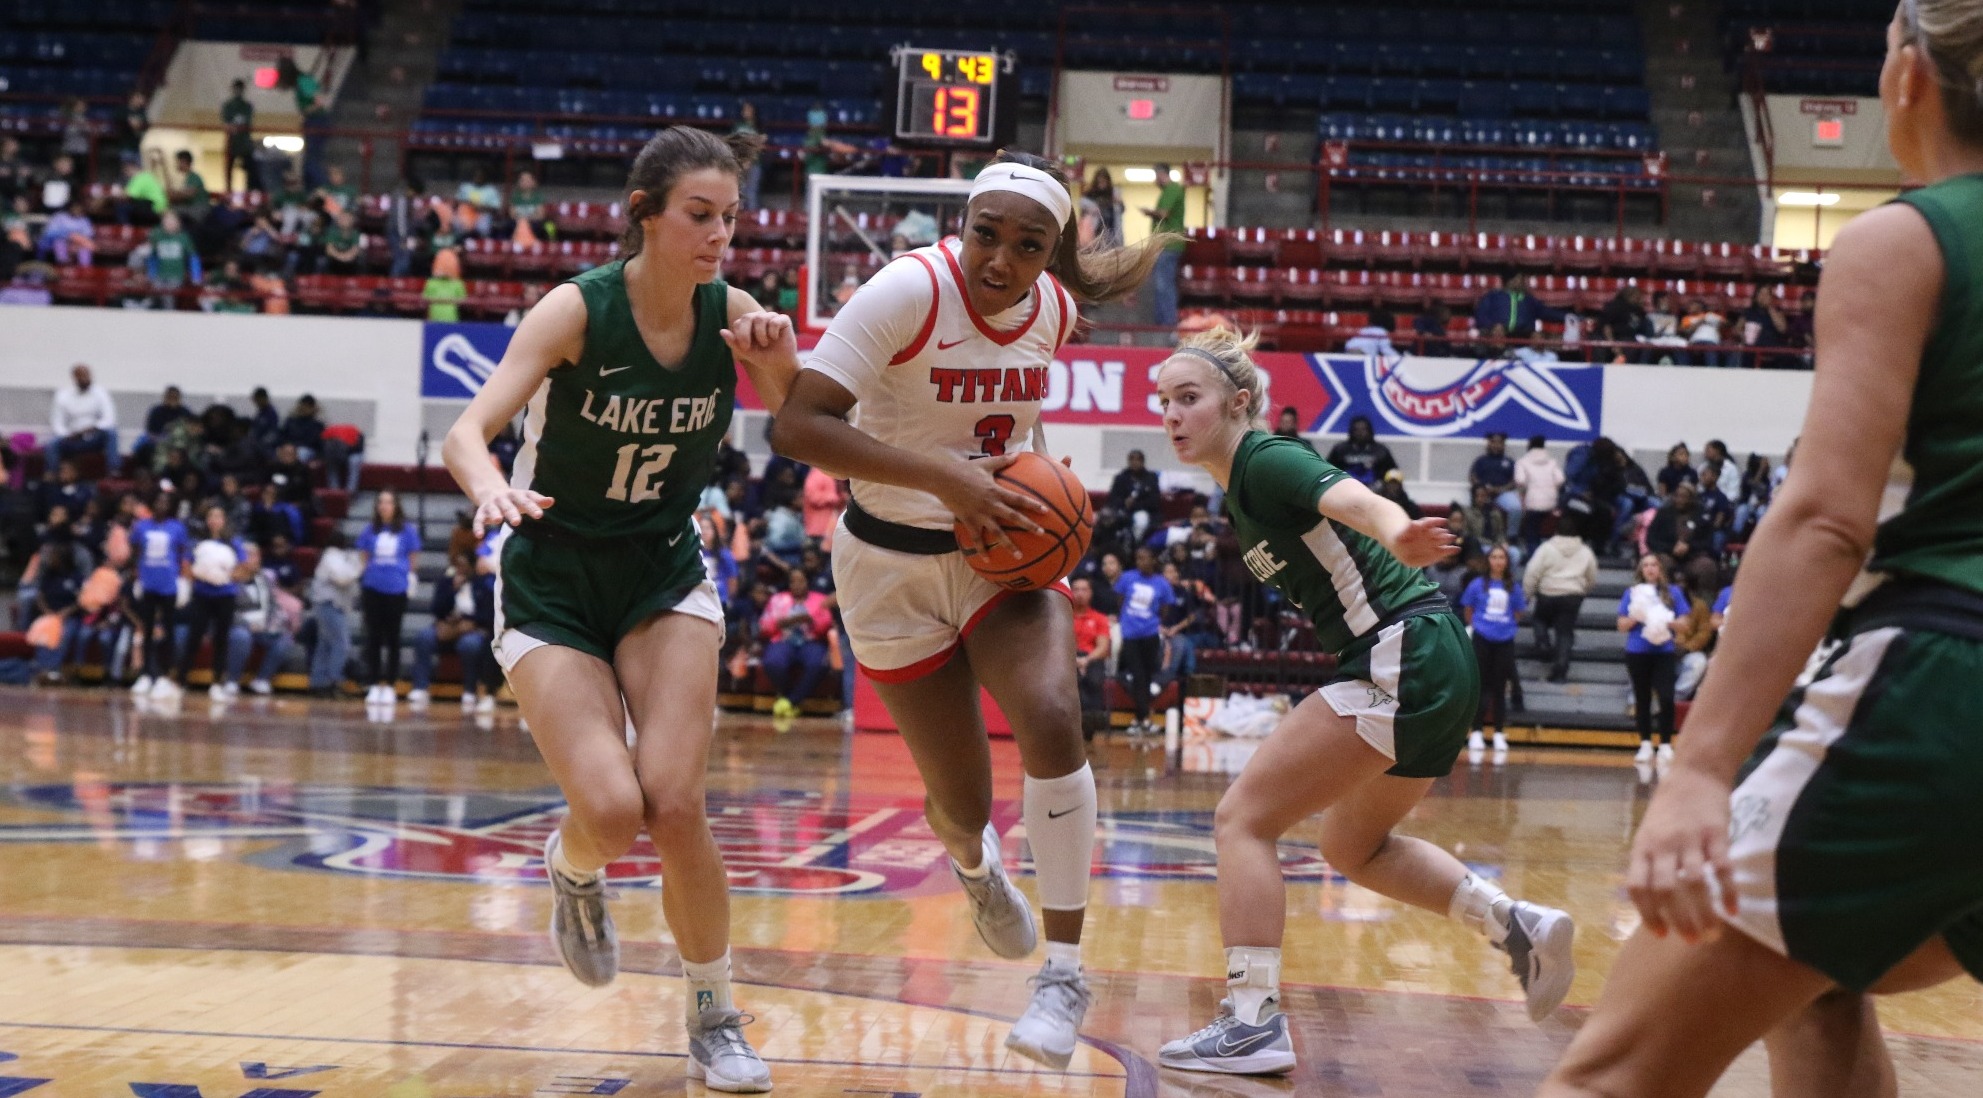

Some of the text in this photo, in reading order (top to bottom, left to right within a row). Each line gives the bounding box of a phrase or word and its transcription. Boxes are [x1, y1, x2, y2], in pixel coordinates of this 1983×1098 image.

[933, 87, 979, 137] 13
[930, 367, 1049, 403] TITANS
[580, 389, 665, 434] LAKE
[968, 414, 1016, 460] 3
[606, 443, 677, 503] 12
